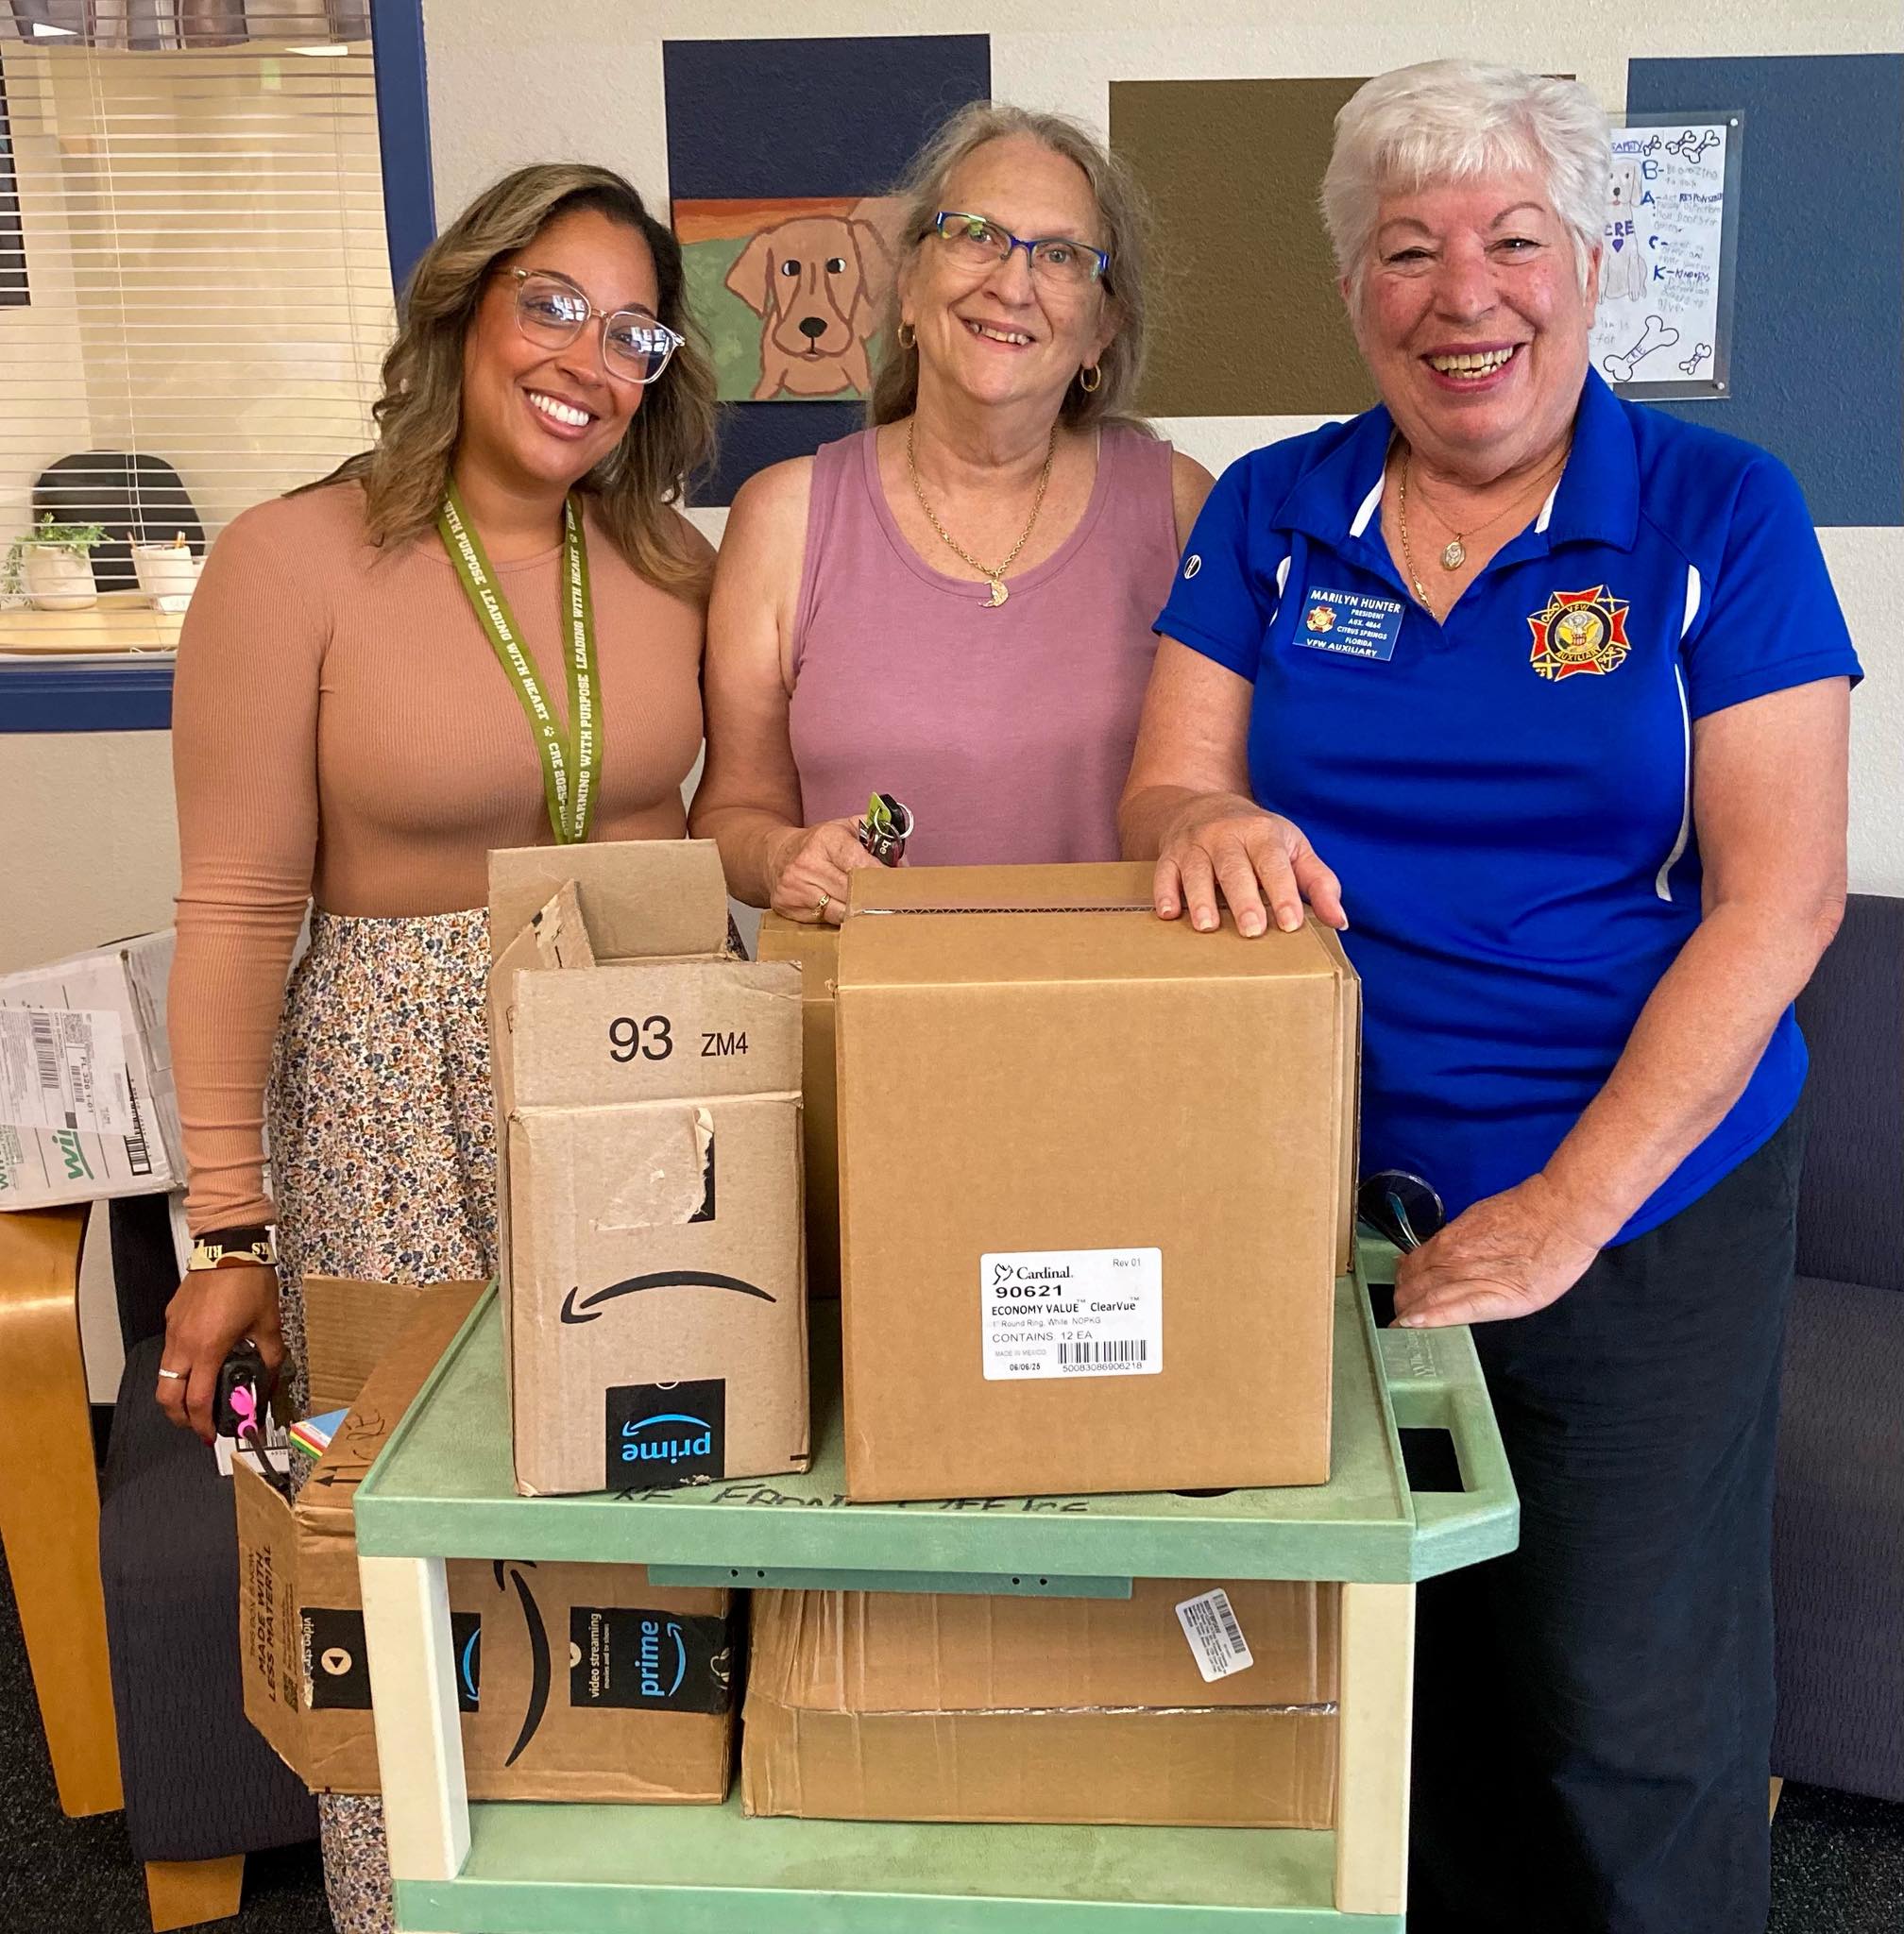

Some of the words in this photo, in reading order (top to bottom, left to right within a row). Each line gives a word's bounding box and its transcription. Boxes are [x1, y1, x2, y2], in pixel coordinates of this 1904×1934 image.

[570, 547, 582, 586] HEART
[571, 585, 584, 619] WITH
[1310, 589, 1359, 606] MARILYN
[1360, 598, 1402, 614] HUNTER
[1351, 609, 1385, 619] PRESIDENT
[1566, 604, 1590, 613] VFW
[443, 500, 463, 534] WITH
[455, 532, 487, 585] PURPOSE
[480, 588, 513, 641] LEADING
[506, 641, 531, 676] WITH
[522, 677, 550, 721] HEART
[549, 742, 564, 770] CRE
[1336, 626, 1359, 636] CITRUS
[1360, 629, 1387, 640] SPRINGS
[1348, 619, 1364, 627] AUX.
[573, 620, 588, 670] LEADING
[1306, 638, 1327, 648] VFW
[1328, 642, 1378, 657] AUXILIARY
[1345, 637, 1373, 648] FLORIDA
[1555, 646, 1603, 662] AUXILIARY
[577, 673, 592, 728] PURPOSE
[580, 729, 592, 768] WITH
[574, 770, 590, 839] LEARNING
[609, 1014, 673, 1063] 93
[701, 1031, 749, 1057] ZM4
[1113, 1258, 1130, 1268] Rev
[1130, 1257, 1142, 1267] 01
[995, 1284, 1063, 1299] 90621
[992, 1305, 1043, 1316] ECONOMY
[1001, 1319, 1026, 1328] Round
[1072, 1316, 1102, 1325] NOPKG
[1062, 1331, 1074, 1341] 12
[1077, 1330, 1093, 1340] EA
[1062, 1361, 1144, 1373] 50083086906218
[621, 1431, 711, 1465] prime
[255, 1551, 265, 1606] WITH
[264, 1544, 275, 1648] MATERIAL
[257, 1611, 267, 1676] MADE
[588, 1613, 602, 1667] streaming
[604, 1642, 610, 1652] tv
[635, 1620, 665, 1697] prime
[266, 1652, 277, 1704] LESS
[588, 1668, 601, 1699] video
